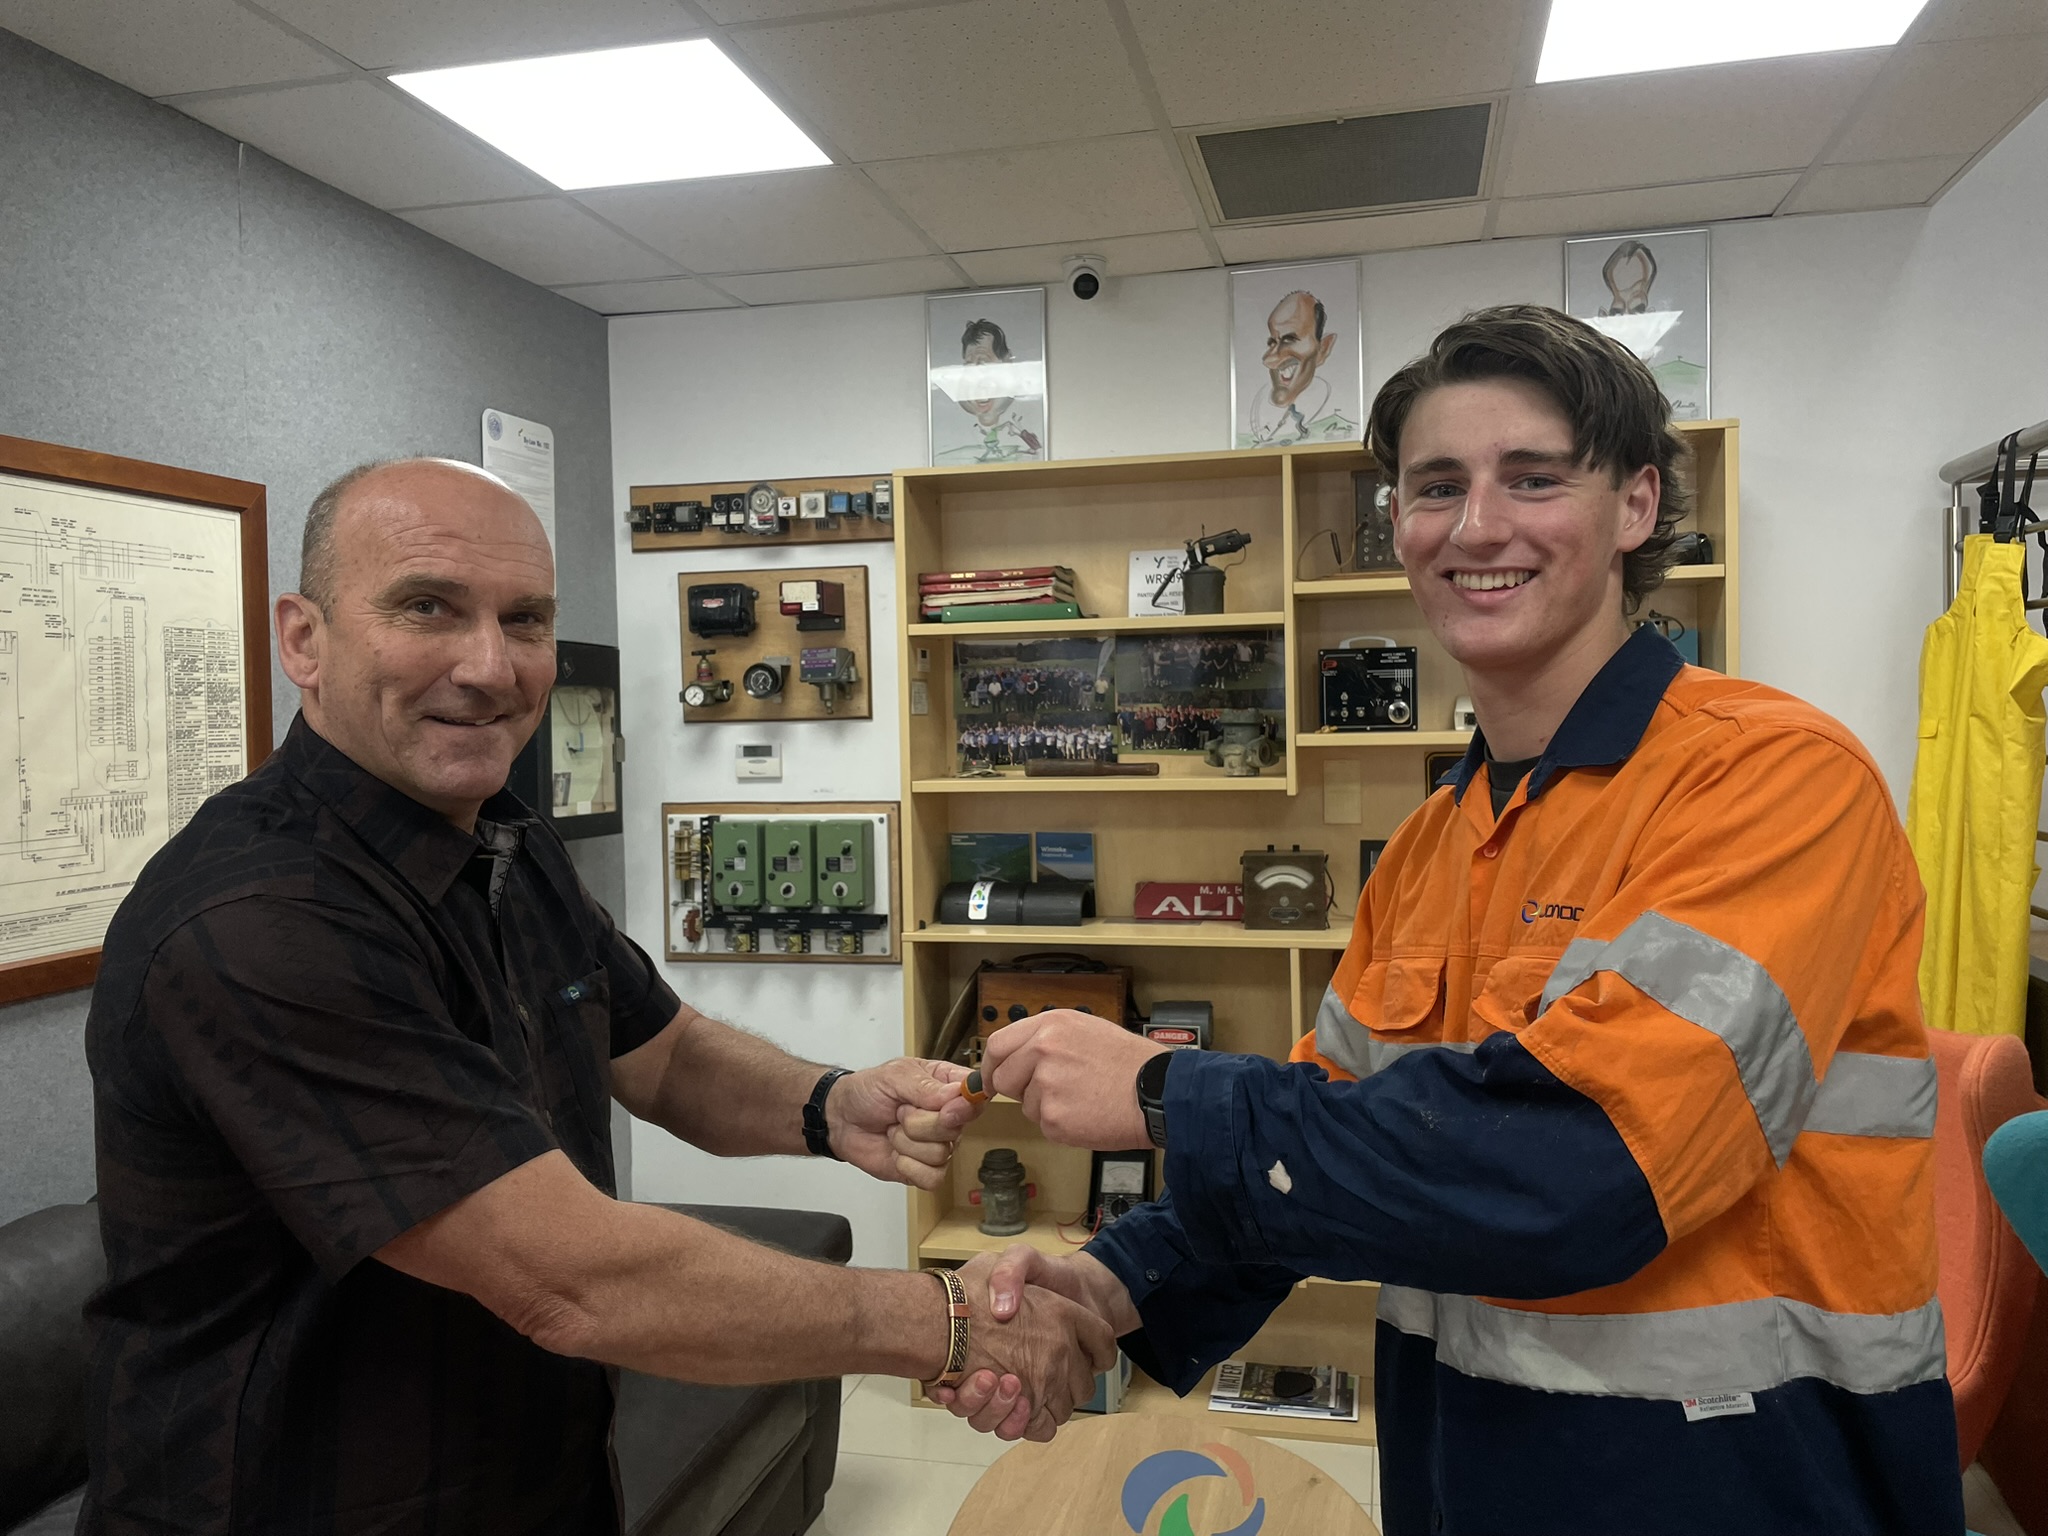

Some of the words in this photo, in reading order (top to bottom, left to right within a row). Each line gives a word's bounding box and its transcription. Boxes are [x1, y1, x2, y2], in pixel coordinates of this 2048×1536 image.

[1153, 1031, 1189, 1040] DANGER
[1217, 1363, 1243, 1393] WATER
[1685, 1398, 1697, 1408] 3M
